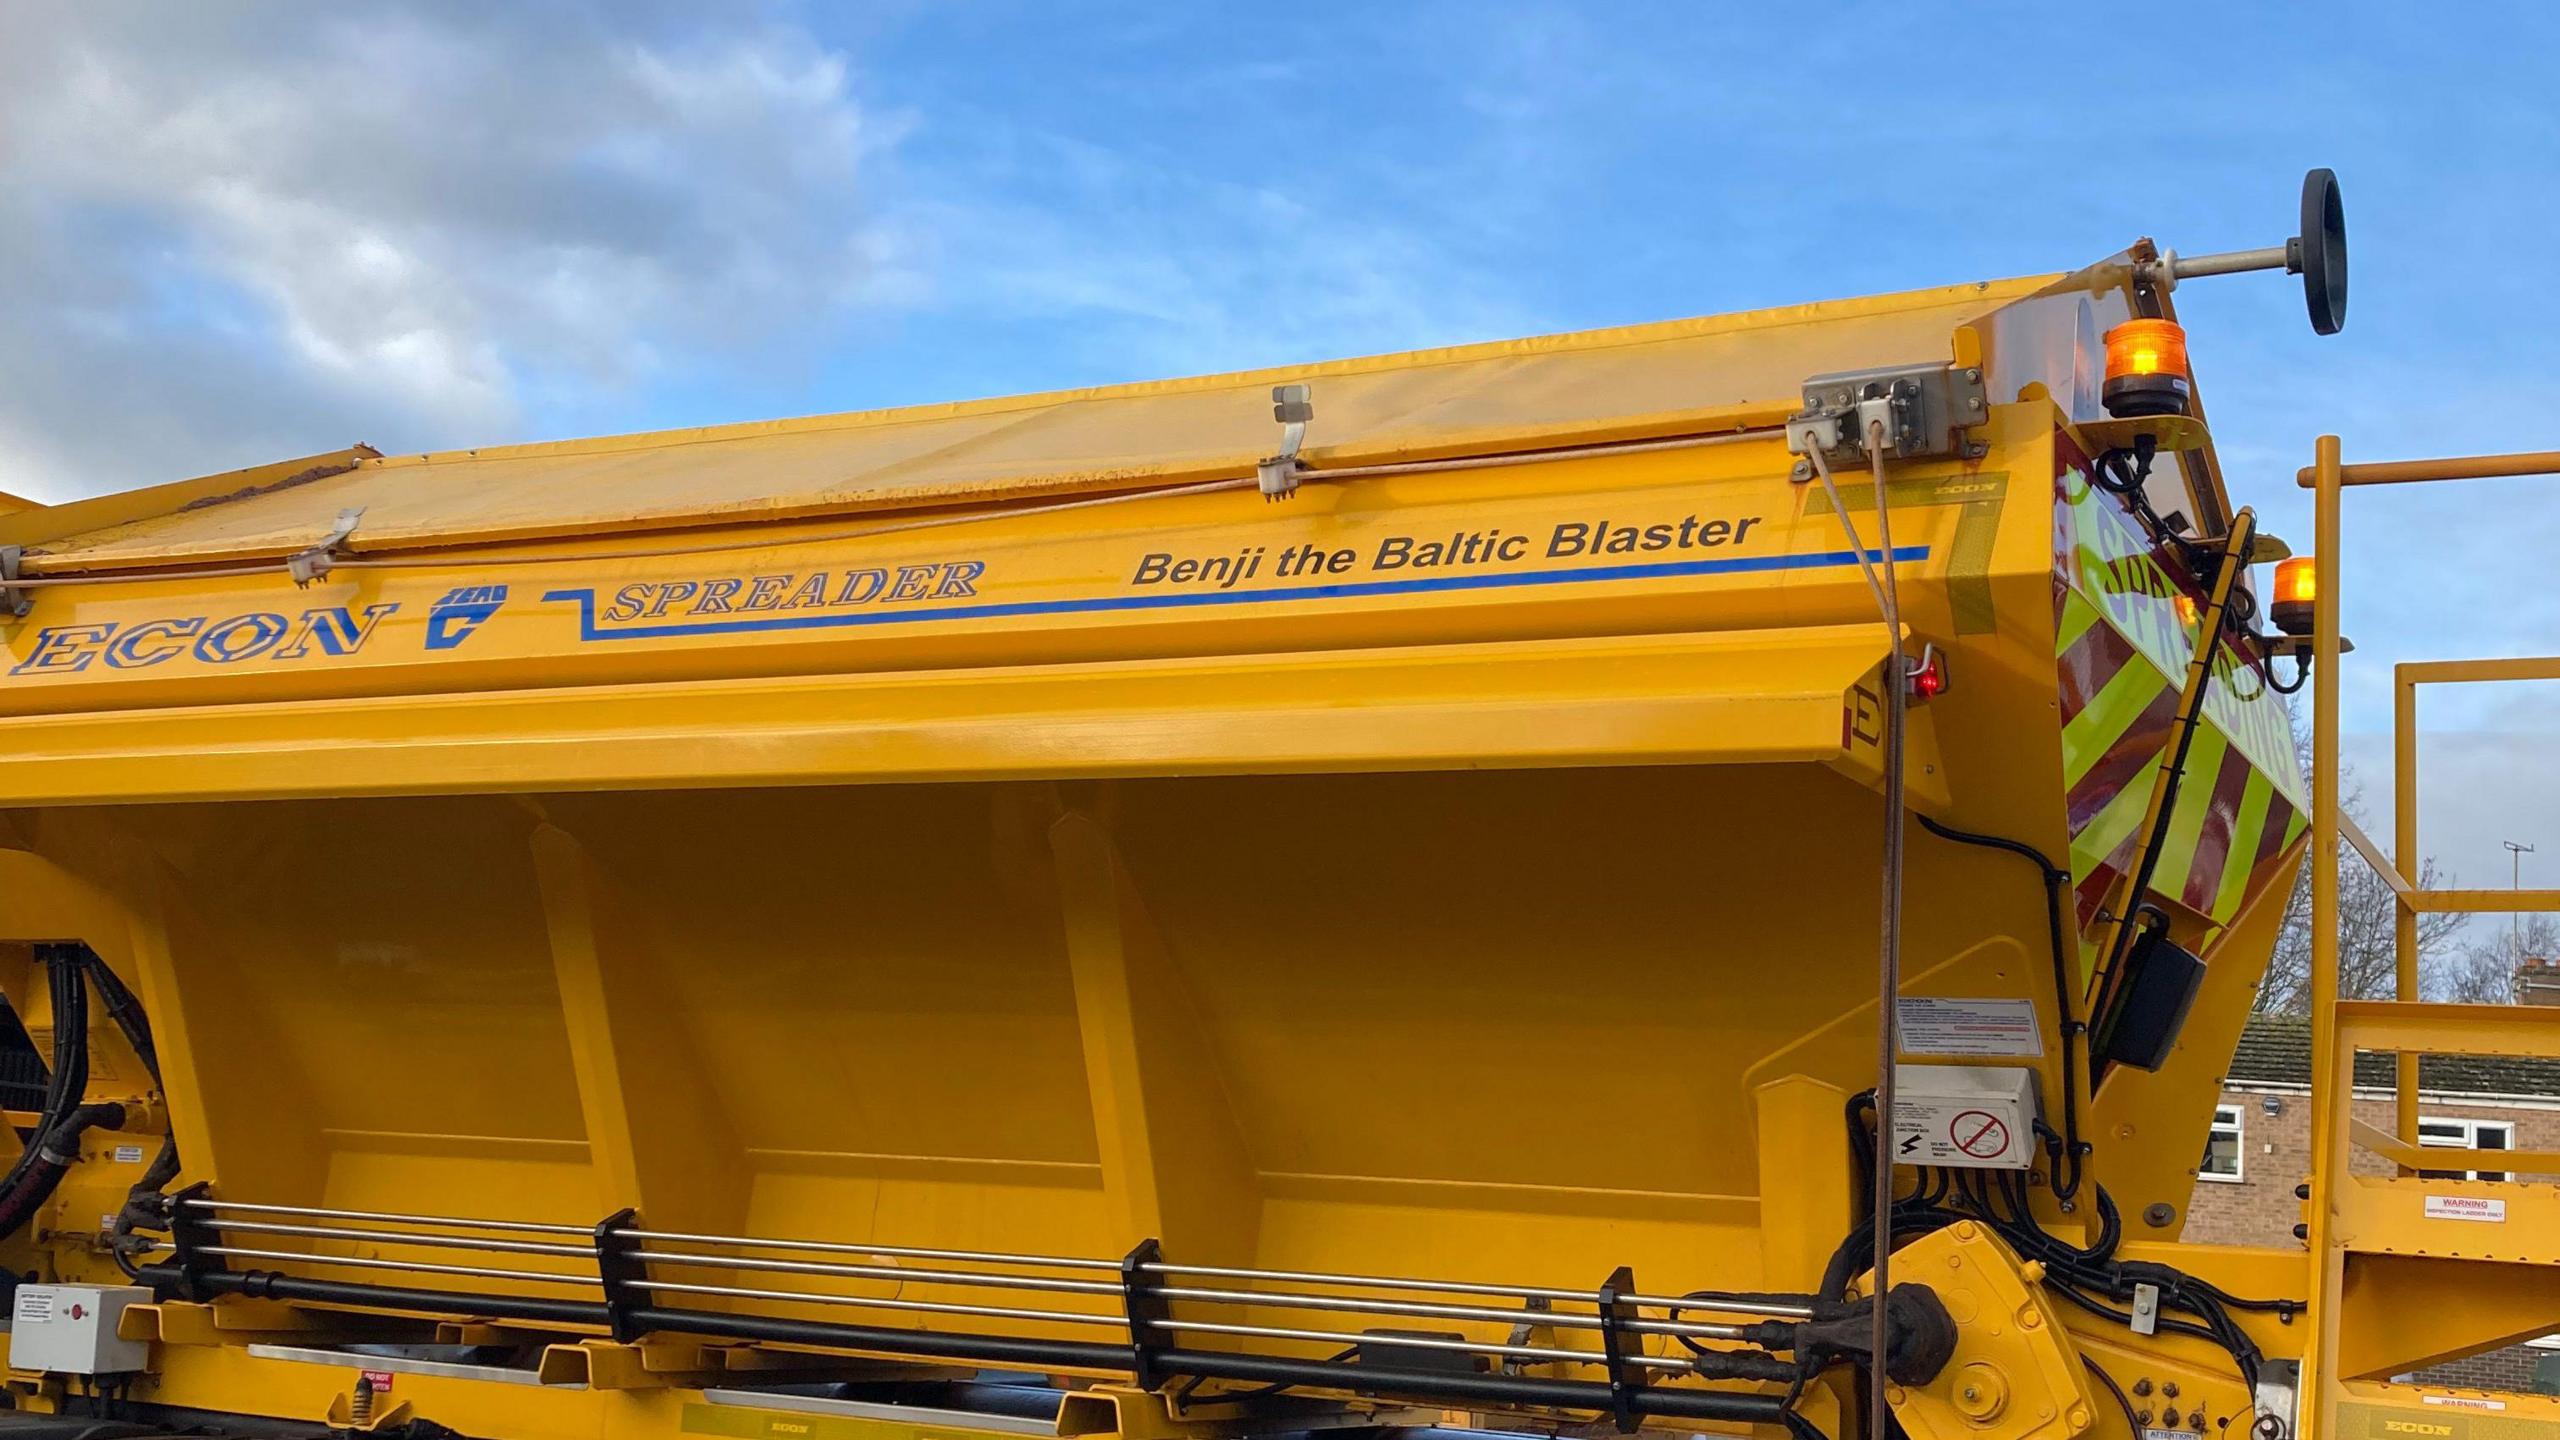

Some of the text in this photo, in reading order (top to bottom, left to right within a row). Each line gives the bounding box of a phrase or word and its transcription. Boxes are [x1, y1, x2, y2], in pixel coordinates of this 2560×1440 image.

[1132, 514, 1763, 588] Benji the Baltic Blaster
[602, 561, 985, 621] SPREADER
[8, 602, 400, 676] ECON
[2442, 1198, 2489, 1209] WARNING
[2384, 1420, 2453, 1436] ECON
